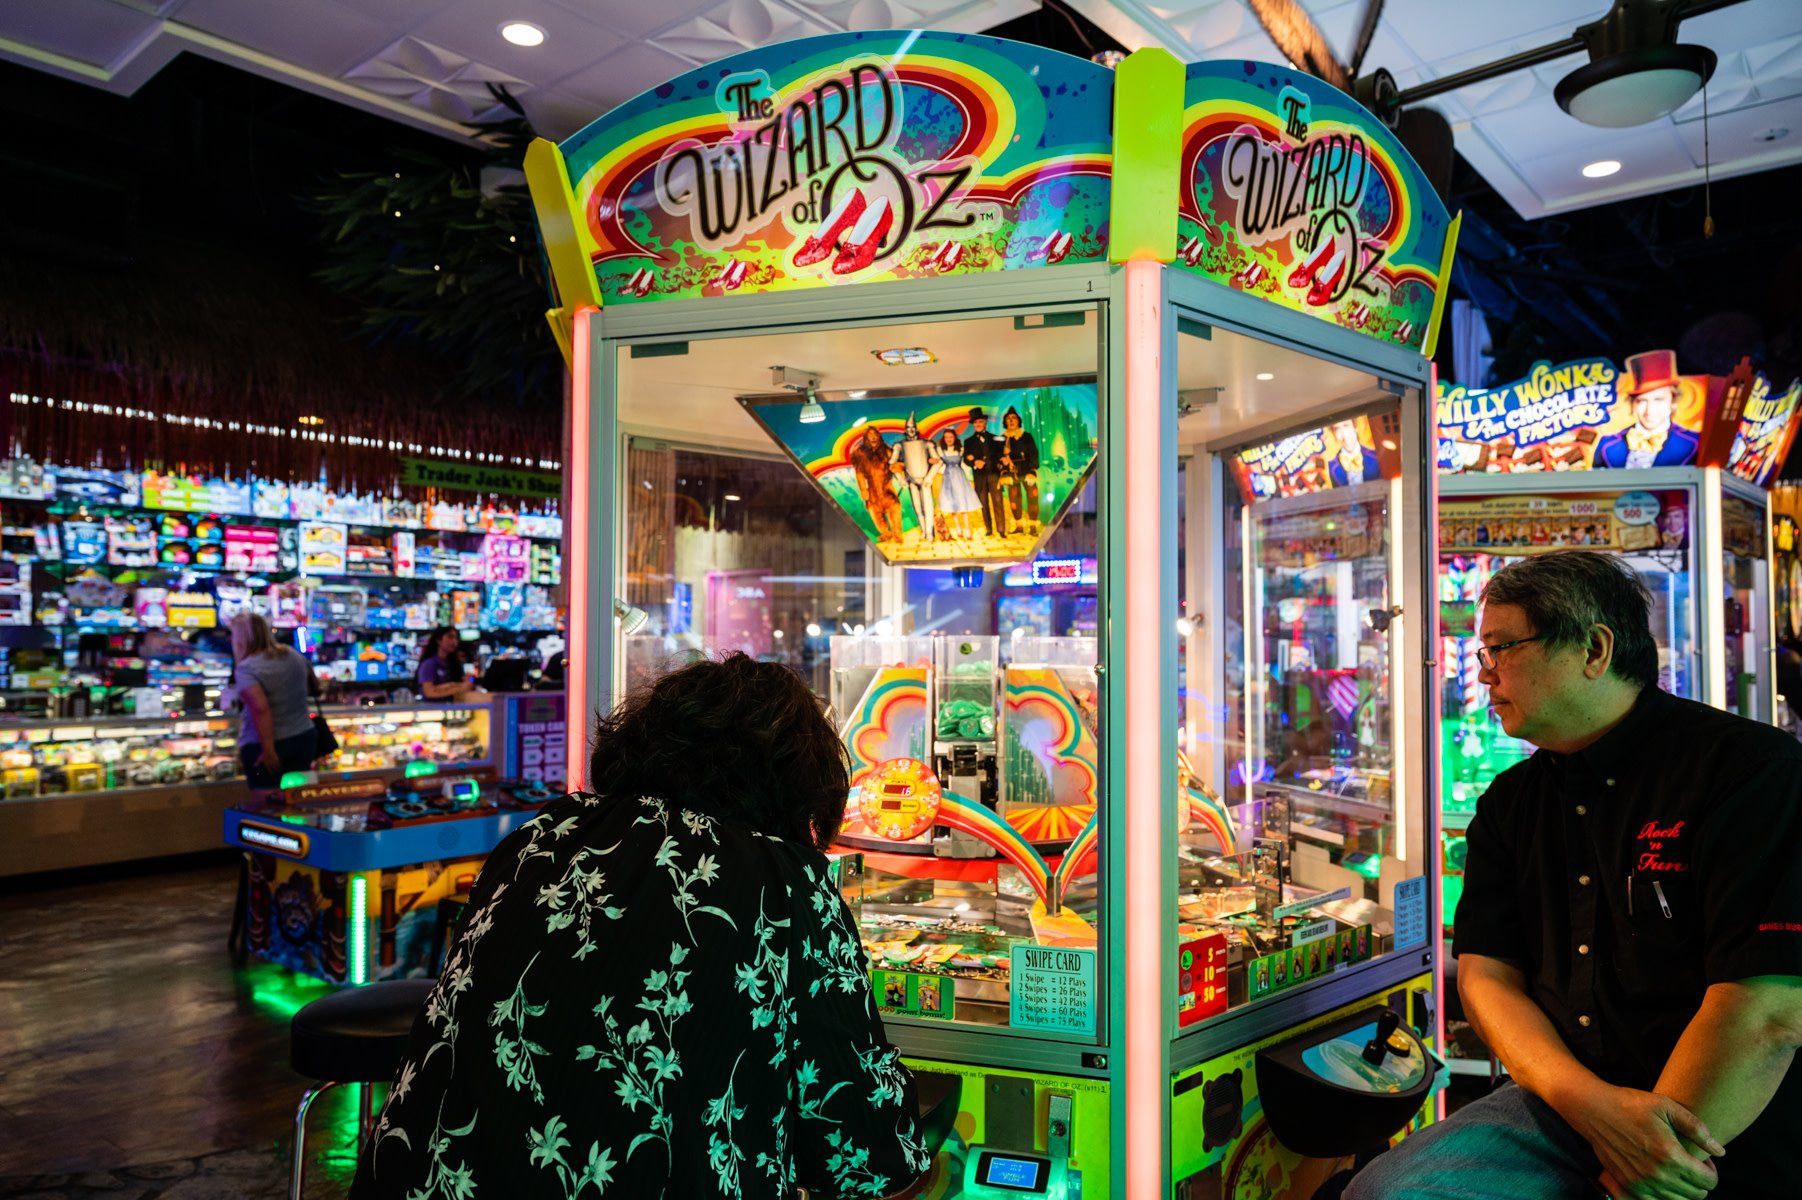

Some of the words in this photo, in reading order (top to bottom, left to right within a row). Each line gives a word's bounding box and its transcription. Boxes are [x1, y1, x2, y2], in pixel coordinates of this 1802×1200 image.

[724, 76, 775, 124] The
[1283, 96, 1308, 142] The
[664, 63, 896, 241] WIZARD
[1228, 133, 1366, 236] WIZARD
[792, 180, 824, 225] of
[1296, 214, 1317, 252] of
[1513, 362, 1615, 408] WONKA
[1505, 384, 1613, 430] CHOCOLATE
[1518, 402, 1605, 445] FACTORY
[1637, 820, 1686, 840] Rock
[1025, 949, 1053, 969] SWIPE
[1056, 952, 1081, 972] CARD
[1208, 947, 1214, 963] 5
[1025, 973, 1045, 984] Swipe
[1058, 976, 1067, 986] 12
[1068, 977, 1087, 988] Plays
[1204, 965, 1215, 983] 10
[1024, 983, 1048, 994] Swipes
[1059, 987, 1068, 995] 26
[1069, 987, 1087, 998] Plays
[1024, 993, 1048, 1004] Swipes
[1069, 998, 1087, 1008] Plays
[1203, 985, 1215, 1003] 50
[1024, 1004, 1048, 1015] Swipes
[1058, 1007, 1068, 1016] 60
[1069, 1008, 1087, 1019] Plays
[1026, 1014, 1049, 1025] Swipes
[1058, 1016, 1067, 1026] 75
[1068, 1018, 1086, 1028] Plays
